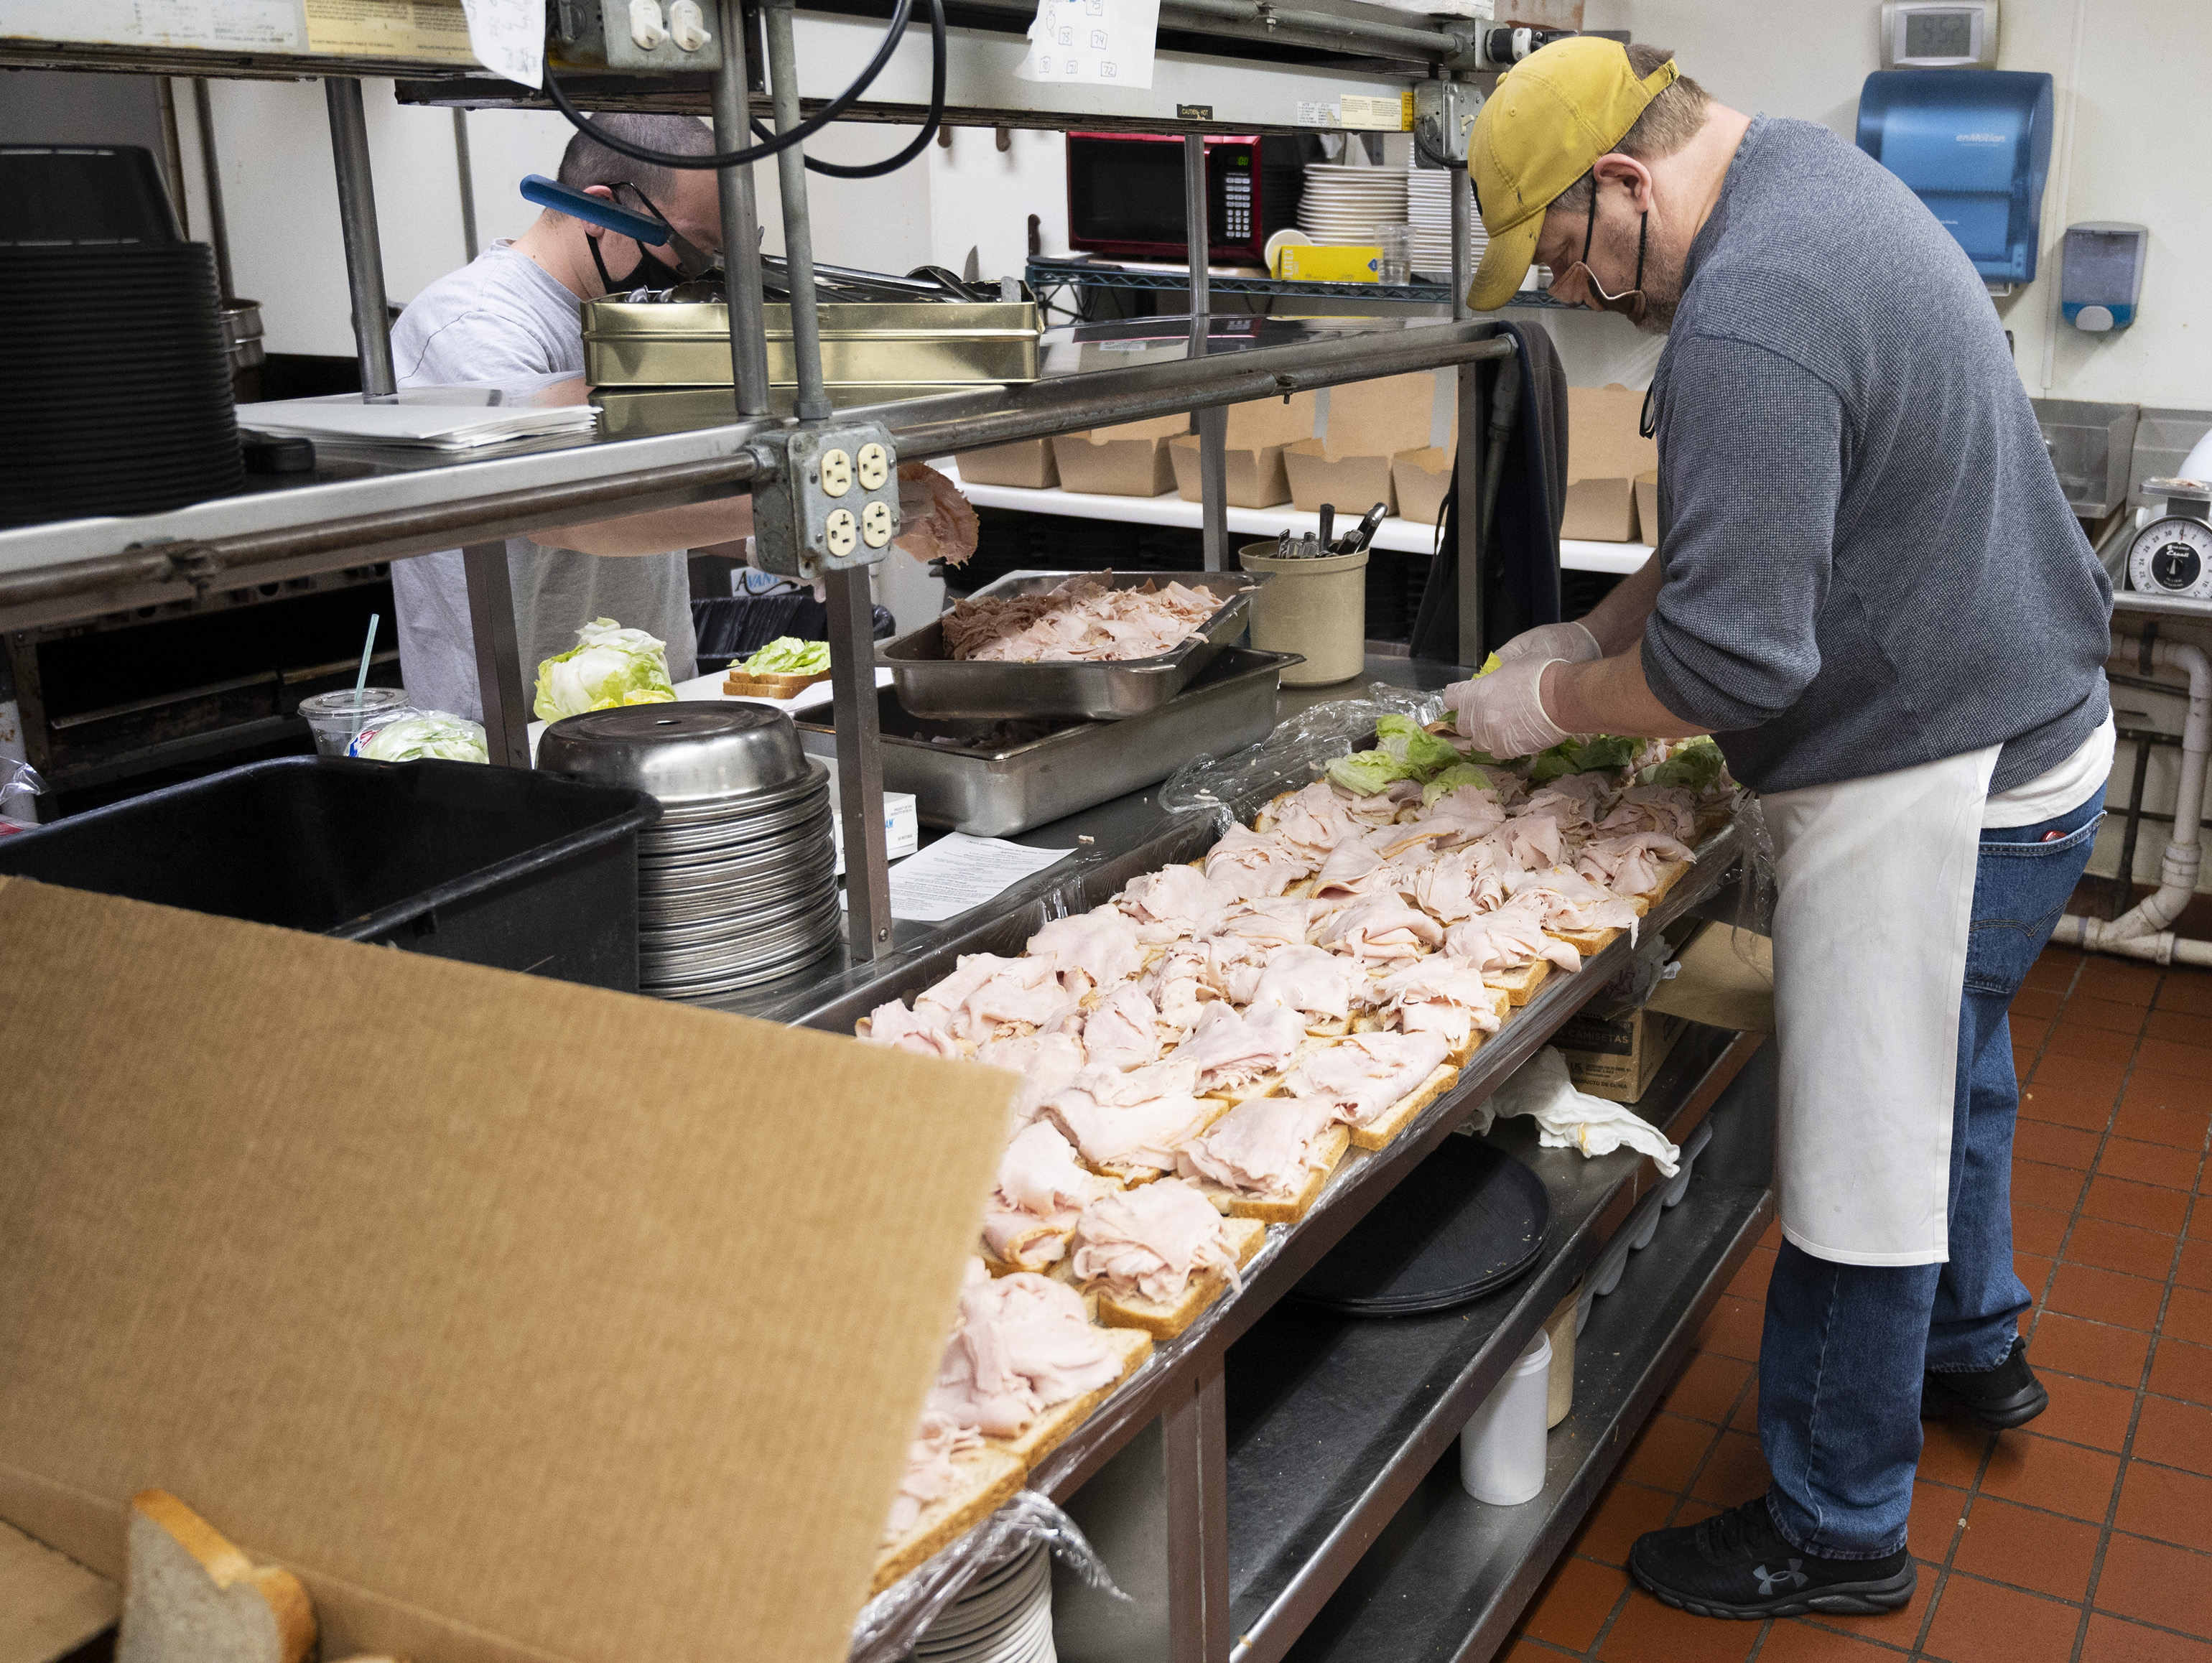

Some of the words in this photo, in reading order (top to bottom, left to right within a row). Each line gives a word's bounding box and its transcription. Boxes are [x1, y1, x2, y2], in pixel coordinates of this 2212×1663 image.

[1093, 34, 1105, 45] 74
[1103, 65, 1114, 76] 72
[1283, 248, 1293, 276] LATEX
[1568, 1030, 1629, 1044] CAMISETAS
